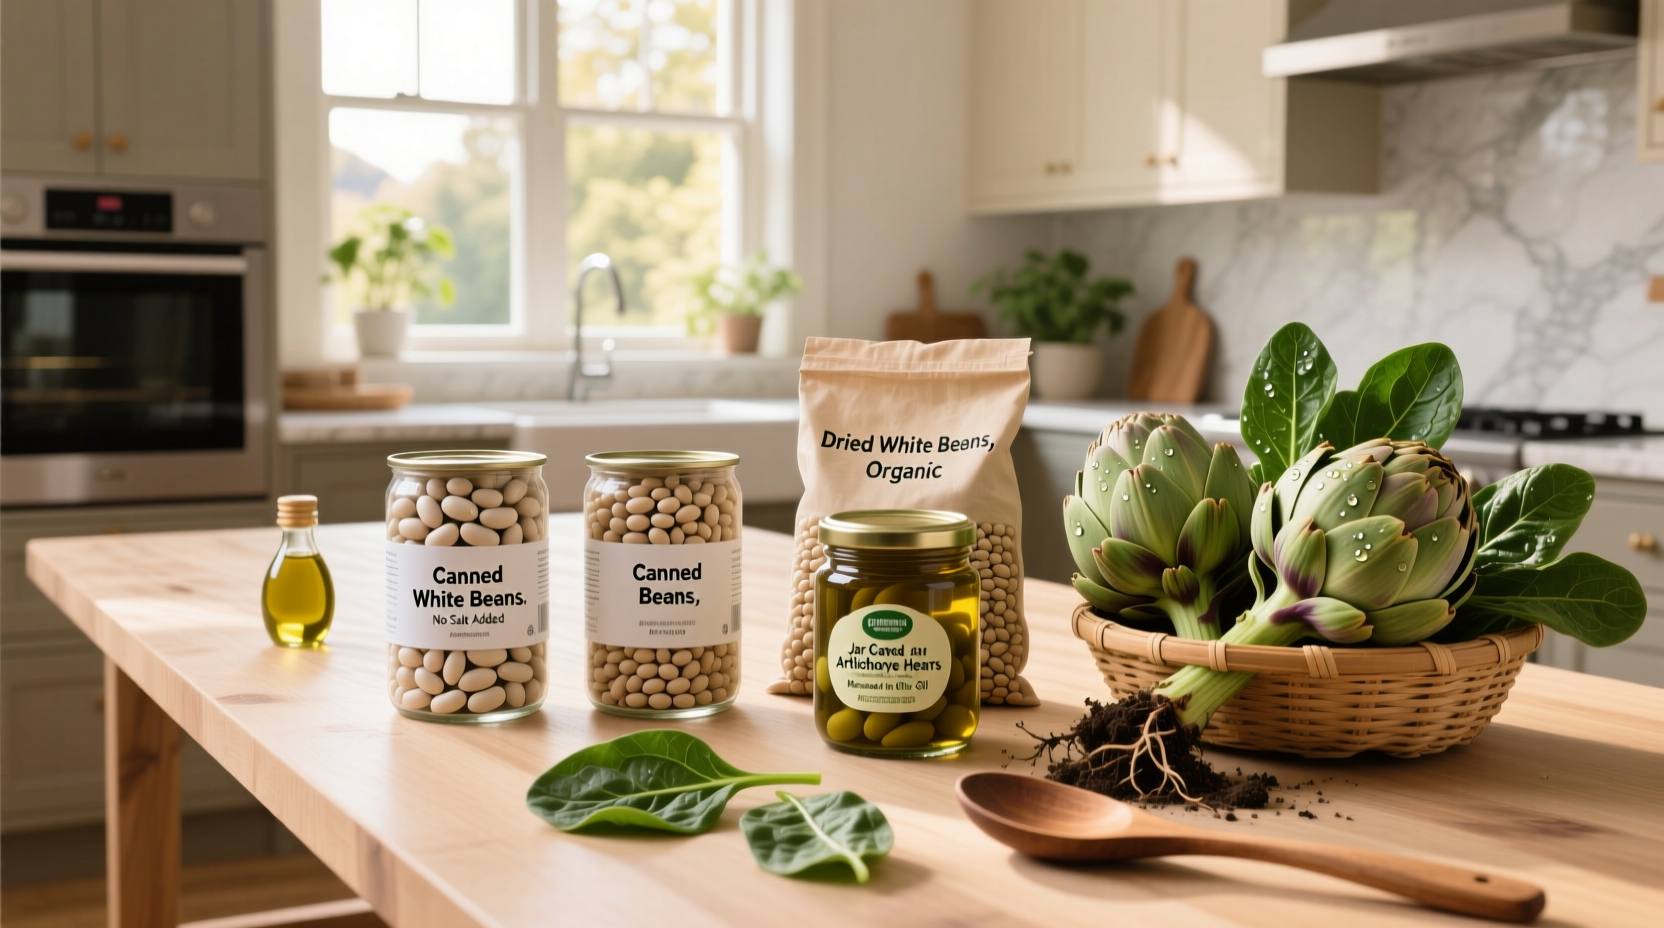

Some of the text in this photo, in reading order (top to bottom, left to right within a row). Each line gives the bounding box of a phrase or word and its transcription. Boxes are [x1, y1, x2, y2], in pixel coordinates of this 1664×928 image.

[821, 430, 995, 454] Dried White Beans,
[866, 460, 942, 484] Organic
[433, 565, 503, 585] Canned
[633, 563, 702, 582] Canned
[413, 589, 464, 608] White
[639, 587, 700, 607] Beans,
[432, 613, 505, 626] No Salt Added
